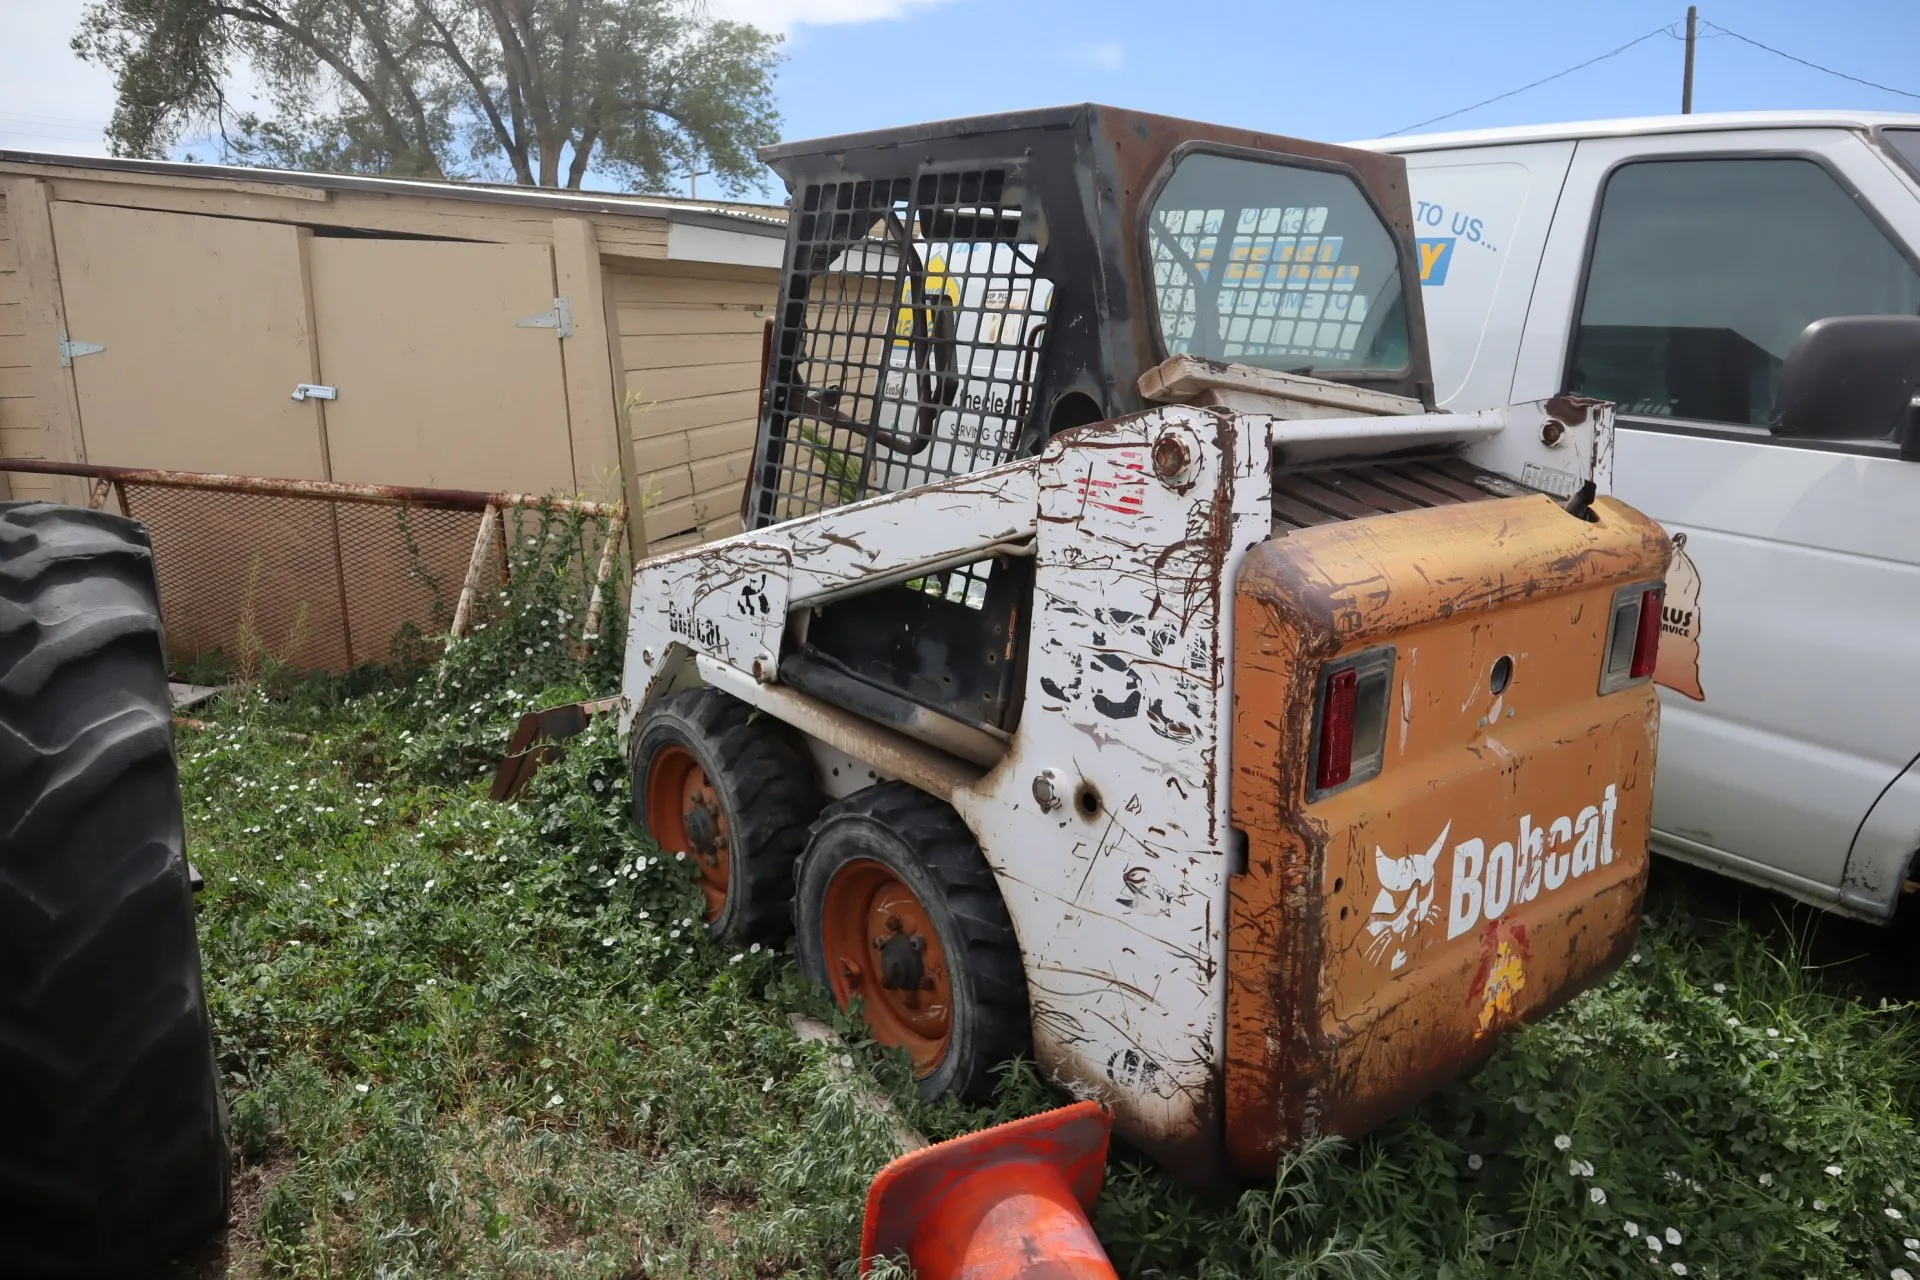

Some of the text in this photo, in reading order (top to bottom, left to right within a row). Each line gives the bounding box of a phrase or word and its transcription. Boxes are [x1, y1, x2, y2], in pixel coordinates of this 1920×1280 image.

[1416, 201, 1443, 226] TO
[1451, 212, 1497, 251] US...
[1662, 606, 1693, 627] LUS
[1447, 784, 1617, 940] Bobcat
